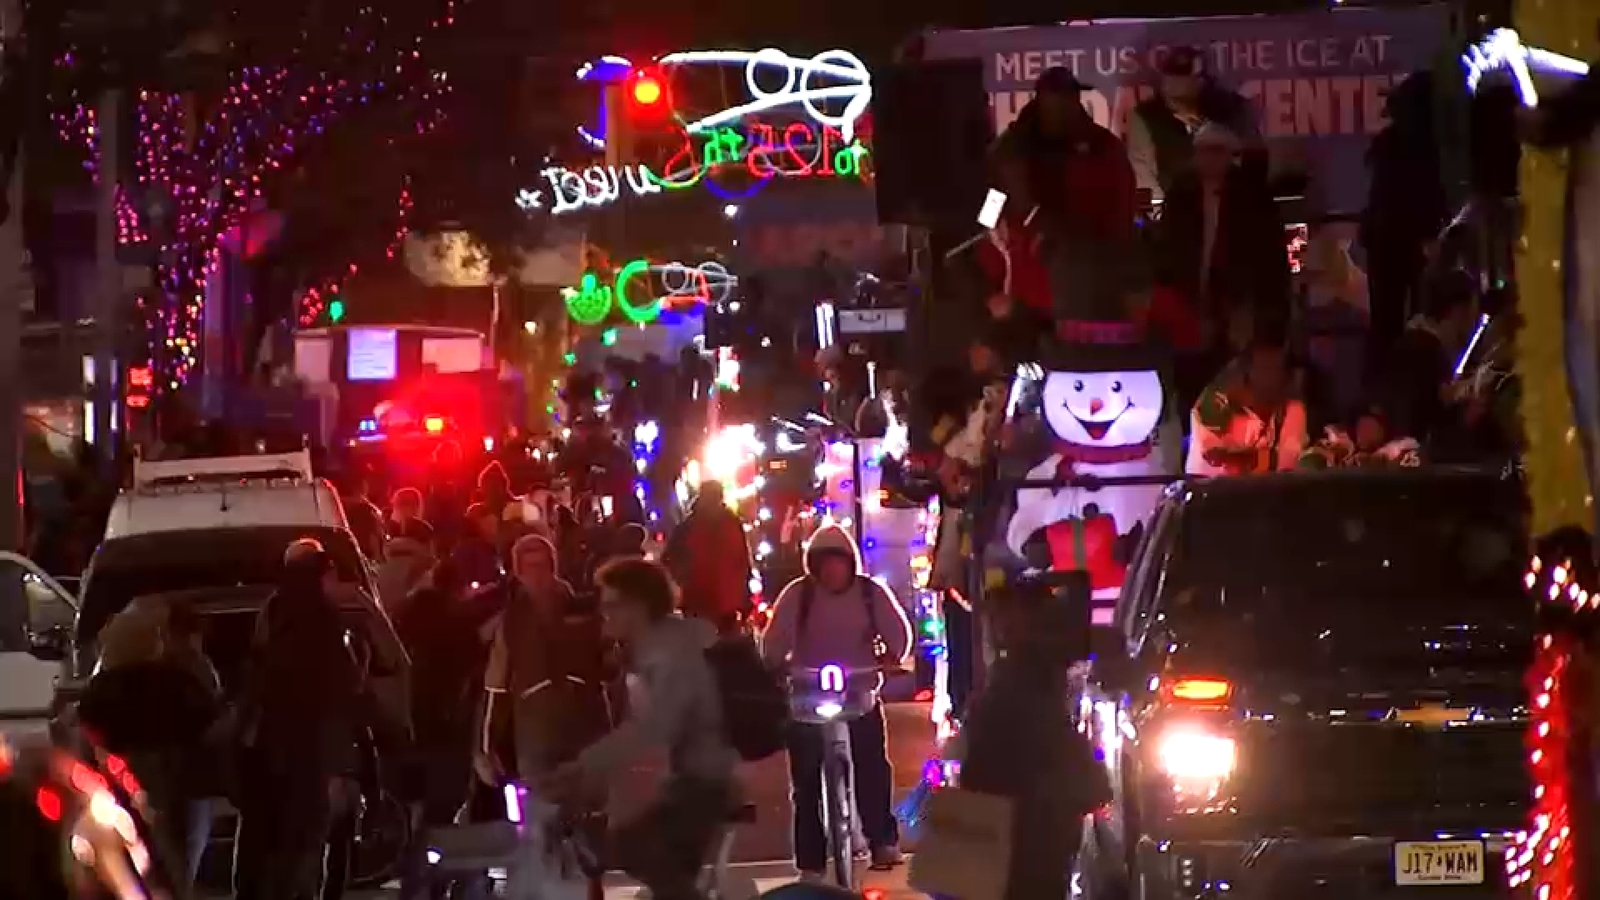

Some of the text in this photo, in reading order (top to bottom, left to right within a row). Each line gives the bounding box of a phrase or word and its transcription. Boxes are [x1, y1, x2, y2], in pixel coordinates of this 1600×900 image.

[996, 49, 1086, 82] MEET
[1094, 46, 1137, 76] US
[1210, 40, 1275, 71] THE
[1286, 36, 1341, 67] ICE
[1349, 34, 1394, 67] AT
[1238, 73, 1411, 137] ENTE
